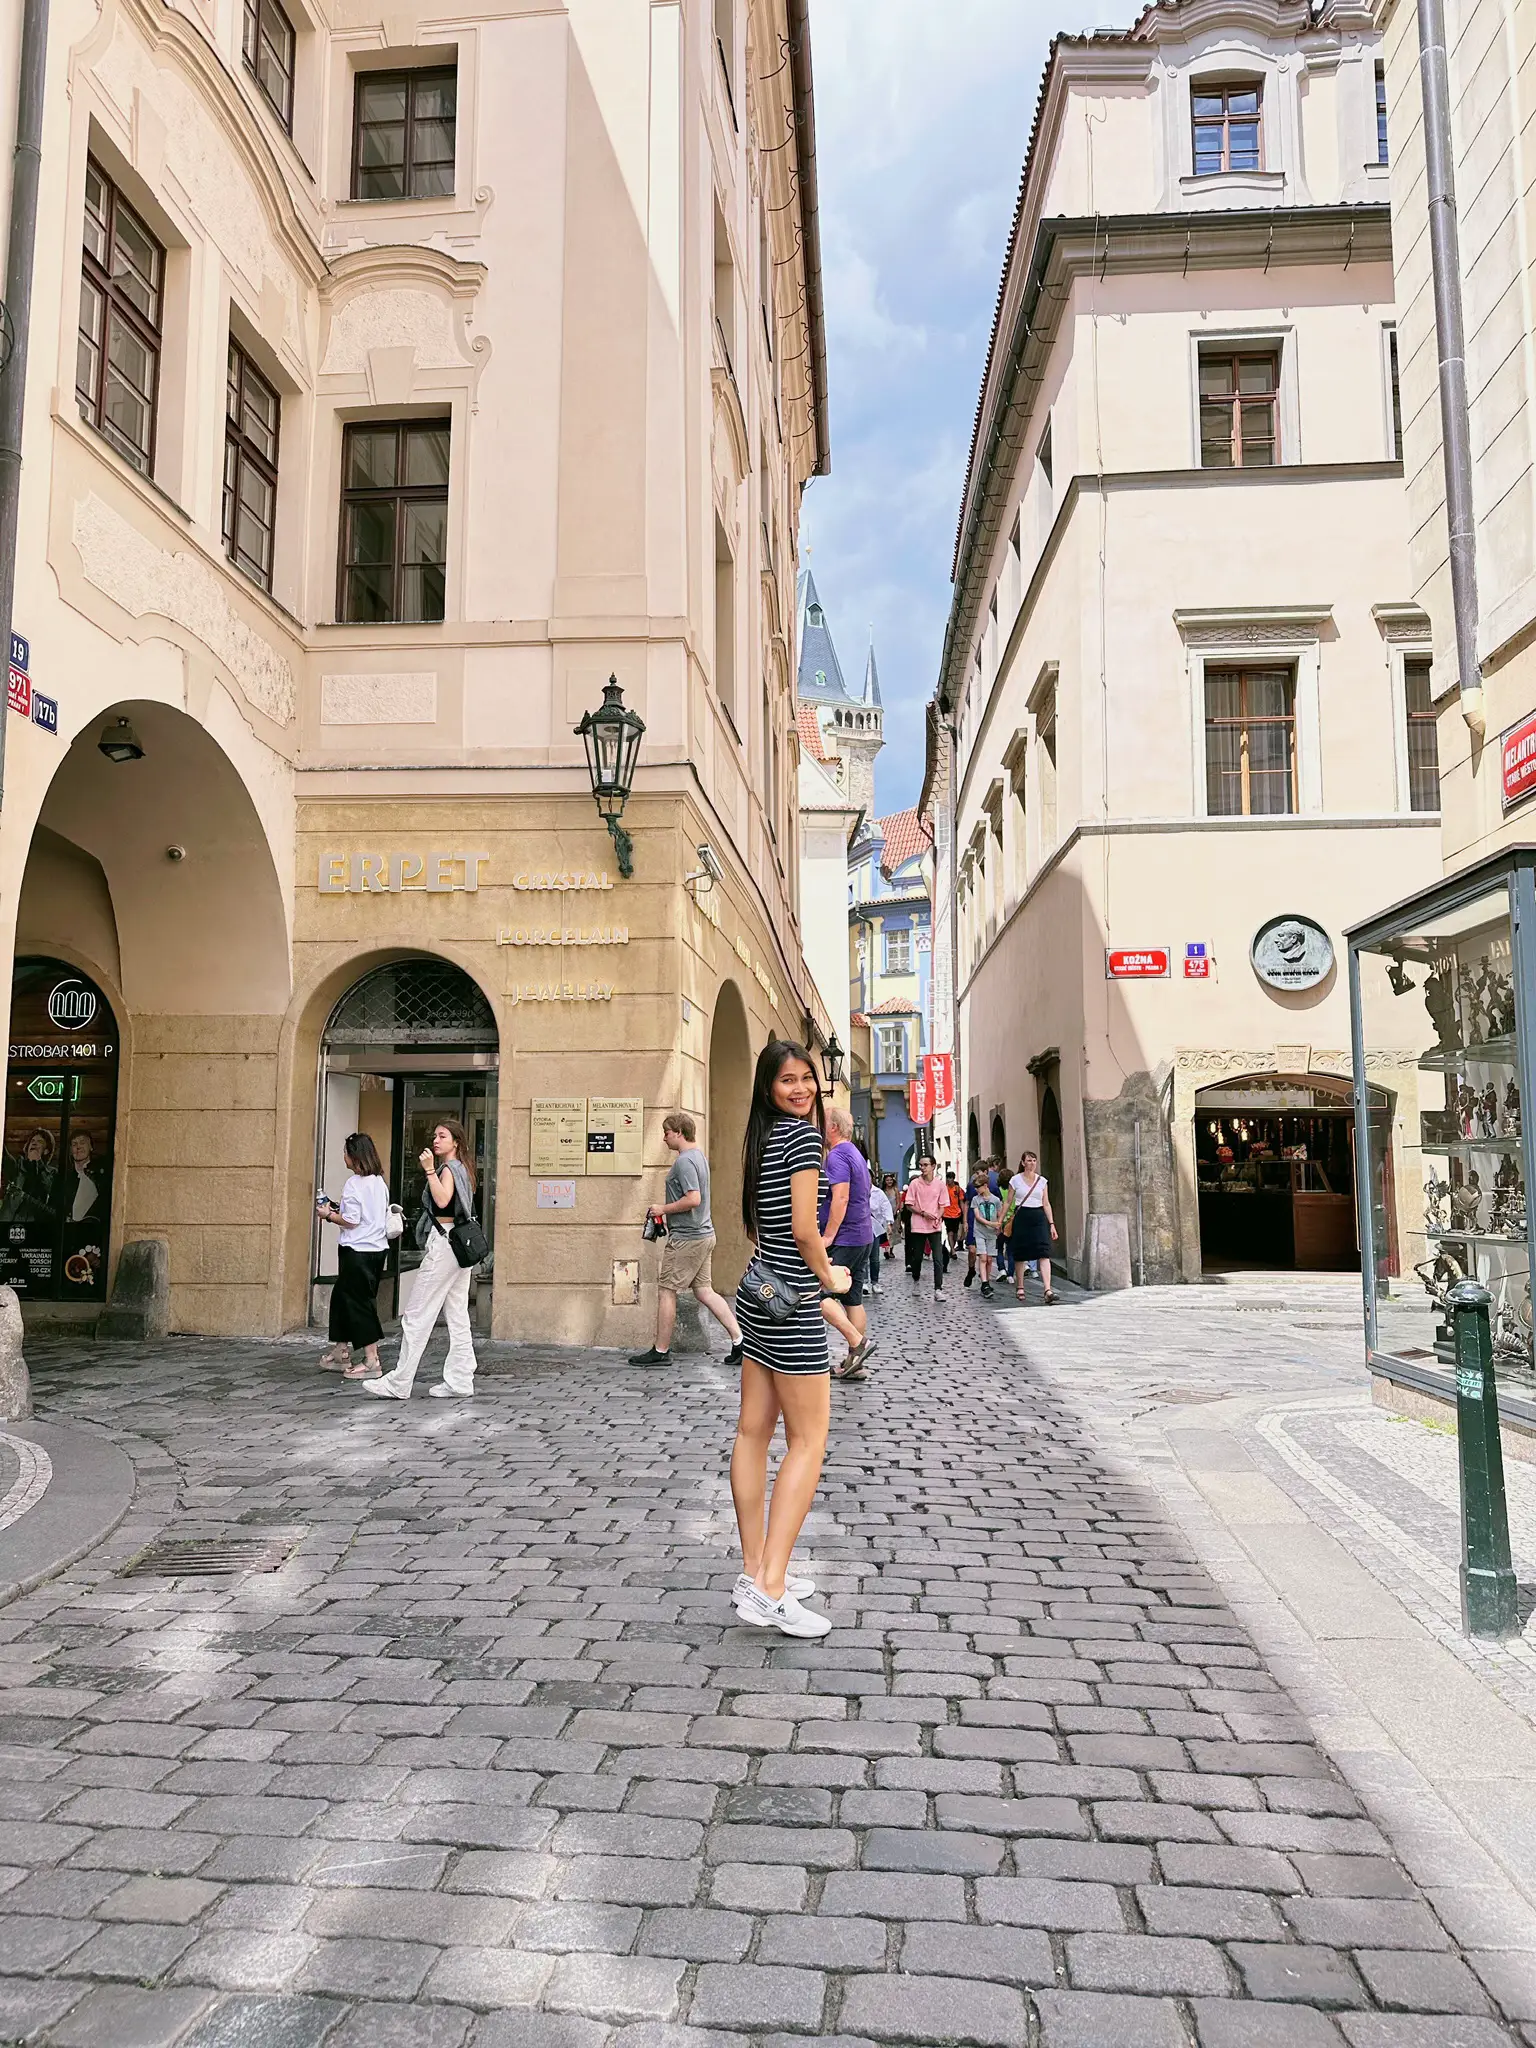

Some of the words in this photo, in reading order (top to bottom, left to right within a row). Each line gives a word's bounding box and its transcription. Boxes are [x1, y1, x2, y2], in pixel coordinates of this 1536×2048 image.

[13, 640, 24, 661] 19
[9, 671, 27, 697] 971
[39, 700, 55, 725] 17b
[318, 852, 490, 893] ERPET
[512, 871, 614, 890] CRYSTAL
[496, 925, 629, 945] PORCELAIN
[1123, 954, 1153, 965] KOŽNÁ
[1194, 945, 1199, 954] 1
[1188, 960, 1205, 969] 475
[512, 983, 615, 1006] JEWELRY
[8, 1045, 69, 1057] STROBAR
[71, 1044, 96, 1056] 1401
[104, 1045, 113, 1057] P
[933, 1071, 946, 1106] MUSEUM
[1224, 1084, 1286, 1101] CANDY
[917, 1093, 926, 1121] MUSEUM
